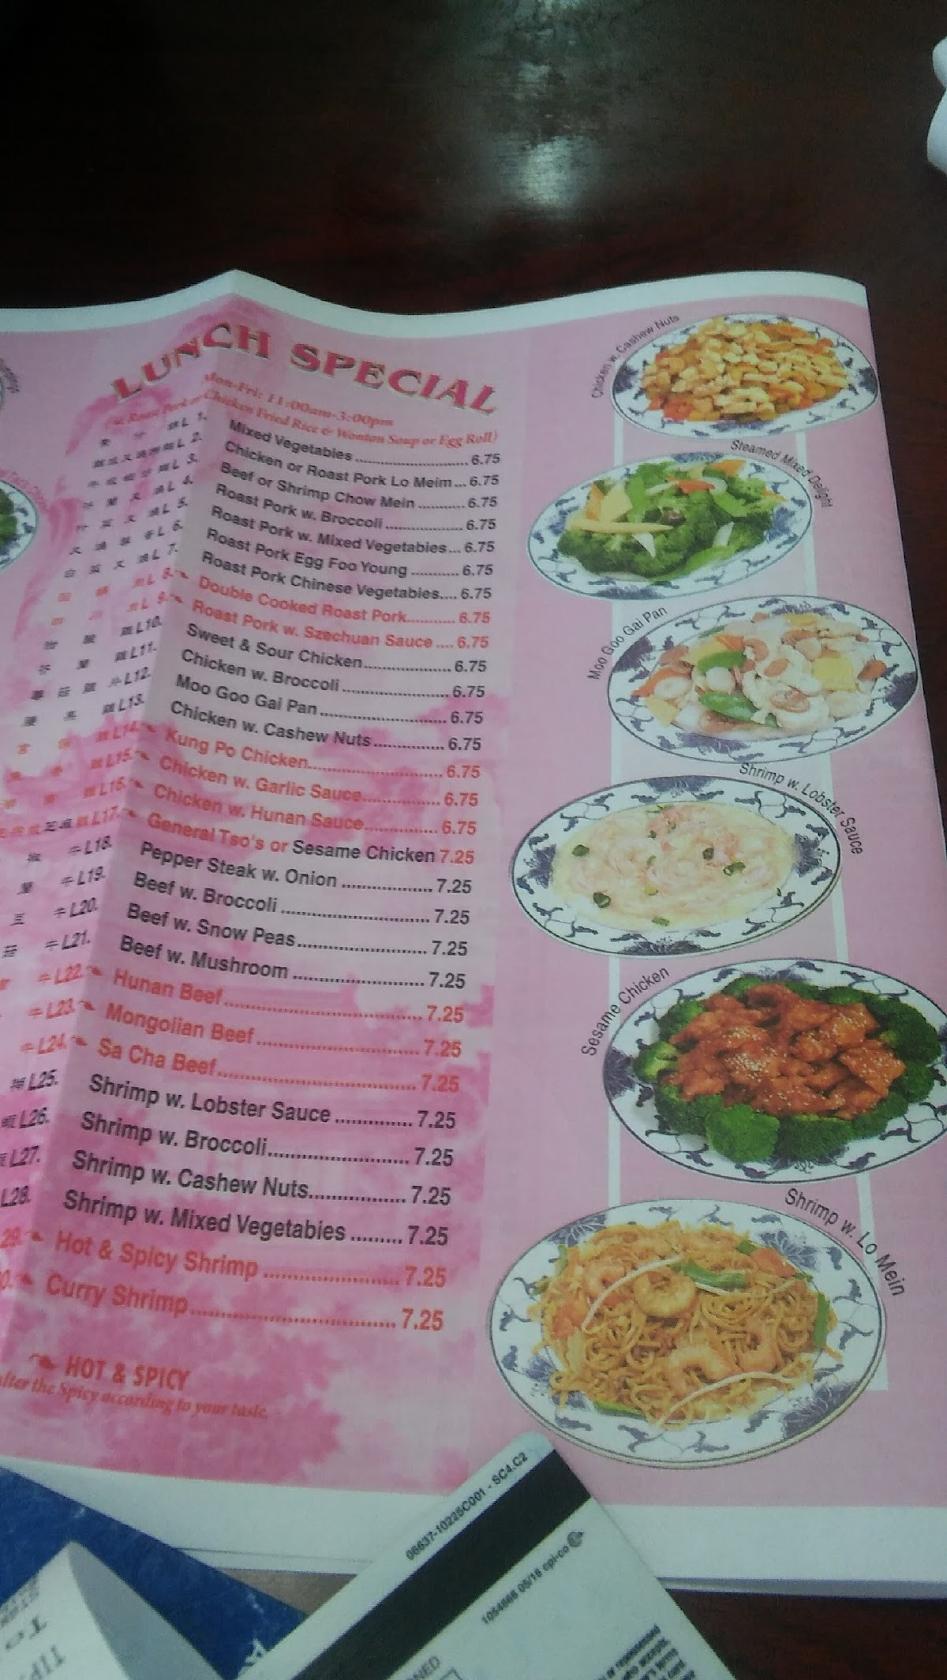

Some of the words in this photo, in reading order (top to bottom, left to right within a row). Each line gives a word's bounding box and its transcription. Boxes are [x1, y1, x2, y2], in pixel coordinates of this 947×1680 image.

[616, 326, 654, 353] Cashew
[655, 315, 680, 330] Nuts
[112, 323, 271, 399] LUNCH
[290, 343, 497, 415] SPECIAL
[229, 419, 272, 442] Mixed
[275, 434, 353, 461] Vegetables
[471, 453, 500, 465] 6.75
[292, 419, 319, 434] Rice
[388, 435, 419, 448] Soup
[439, 435, 462, 448] Egg
[731, 440, 782, 460] Steamed
[780, 454, 813, 477] Mixed
[221, 462, 254, 480] Beef
[258, 477, 273, 487] or
[277, 480, 330, 502] Shrimp
[335, 491, 376, 506] Chow
[380, 496, 415, 508] Mein
[468, 496, 498, 508] 6.75
[225, 441, 283, 468] Chicken
[287, 462, 303, 473] or
[307, 465, 349, 481] Roast
[353, 472, 386, 486] Pork
[391, 476, 409, 487] Lo
[469, 475, 499, 487] 6.75
[202, 551, 246, 575] Roast
[251, 566, 286, 584] Pork
[290, 575, 352, 594] Chinese
[356, 584, 440, 600] Vegetables
[460, 588, 492, 600] 6.75
[207, 528, 250, 552] Roast
[255, 544, 290, 561] Pork
[294, 552, 324, 570] Egg
[328, 557, 357, 571] Foo
[361, 561, 407, 578] Young
[463, 564, 493, 576] 6.75
[186, 623, 235, 648] Sweet
[240, 639, 250, 652] &
[256, 642, 294, 660] Sour
[298, 649, 362, 668] Chicken
[454, 660, 487, 672] 6.75
[587, 657, 608, 680] Moo
[601, 635, 624, 656] Goo
[622, 618, 644, 636] Gai
[642, 607, 668, 623] Pan
[181, 649, 246, 677] Chicken
[251, 669, 267, 681] w.
[273, 671, 339, 691] Broccoli
[452, 686, 485, 698] 6.75
[171, 700, 237, 728] Chicken
[242, 720, 258, 733] w.
[263, 722, 328, 742] Cashew
[334, 731, 372, 747] Nuts
[448, 737, 481, 750] 6.75
[739, 762, 785, 785] Shrimp
[787, 778, 799, 790] w.
[801, 783, 845, 818] Lobster
[840, 817, 863, 855] Sauce
[148, 813, 214, 841] General
[218, 829, 265, 850] Tso's
[270, 839, 288, 852] or
[292, 840, 361, 860] Sesame
[366, 845, 435, 863] Chicken
[440, 850, 474, 865] 7.25
[140, 841, 203, 869] Pepper
[207, 858, 257, 879] Steak
[262, 868, 279, 882] w.
[285, 868, 337, 888] Onion
[437, 878, 472, 894] 7.25
[133, 871, 175, 896] Beef
[180, 885, 197, 900] w.
[202, 888, 277, 912] Broccoli
[434, 908, 470, 925] 7.25
[127, 902, 170, 927] Beef
[173, 918, 191, 932] w.
[196, 919, 248, 941] Snow
[252, 927, 296, 947] Peas
[432, 940, 468, 956] 7.25
[120, 934, 163, 960] Beef
[167, 950, 185, 965] w.
[190, 951, 288, 979] Mushroom
[428, 971, 466, 989] 7.25
[113, 967, 174, 998] Hunan
[179, 982, 223, 1005] Beef
[427, 1005, 464, 1023] 7.25
[581, 1004, 620, 1056] Sesame
[618, 967, 670, 1005] Chicken
[105, 1003, 204, 1035] Mongolian
[211, 1023, 255, 1044] Beef
[424, 1039, 461, 1058] 7.25
[97, 1037, 122, 1060] Sa
[128, 1044, 165, 1069] Cha
[171, 1053, 217, 1075] Beef
[421, 1074, 460, 1093] 7.25
[88, 1073, 160, 1108] Shrimp
[166, 1096, 185, 1108] w.
[191, 1092, 266, 1118] Lobster
[271, 1101, 331, 1123] Sauce
[417, 1110, 456, 1129] 7.25
[80, 1111, 152, 1146] Shrimp
[159, 1129, 178, 1146] w.
[184, 1129, 267, 1156] Broccoli
[414, 1147, 454, 1167] 7.25
[72, 1149, 145, 1185] Shrimp
[151, 1168, 171, 1185] w.
[177, 1168, 257, 1195] Cashew
[263, 1176, 309, 1199] Nuts
[411, 1185, 451, 1206] 7.25
[55, 1230, 92, 1256] Hot
[99, 1239, 113, 1260] &
[120, 1241, 177, 1274] Spicy
[184, 1250, 258, 1282] Shrimp
[405, 1265, 447, 1288] 7.25
[784, 1187, 839, 1225] Shrimp
[840, 1219, 856, 1238] w.
[856, 1231, 878, 1255] Lo
[875, 1253, 905, 1296] Mein
[46, 1273, 107, 1308] Curry
[112, 1284, 188, 1318] Shrimp
[402, 1308, 444, 1331] 7.25
[65, 1355, 107, 1381] HOT
[112, 1361, 126, 1384] &
[133, 1363, 192, 1392] SPICY
[492, 1451, 528, 1486] SC4.C2
